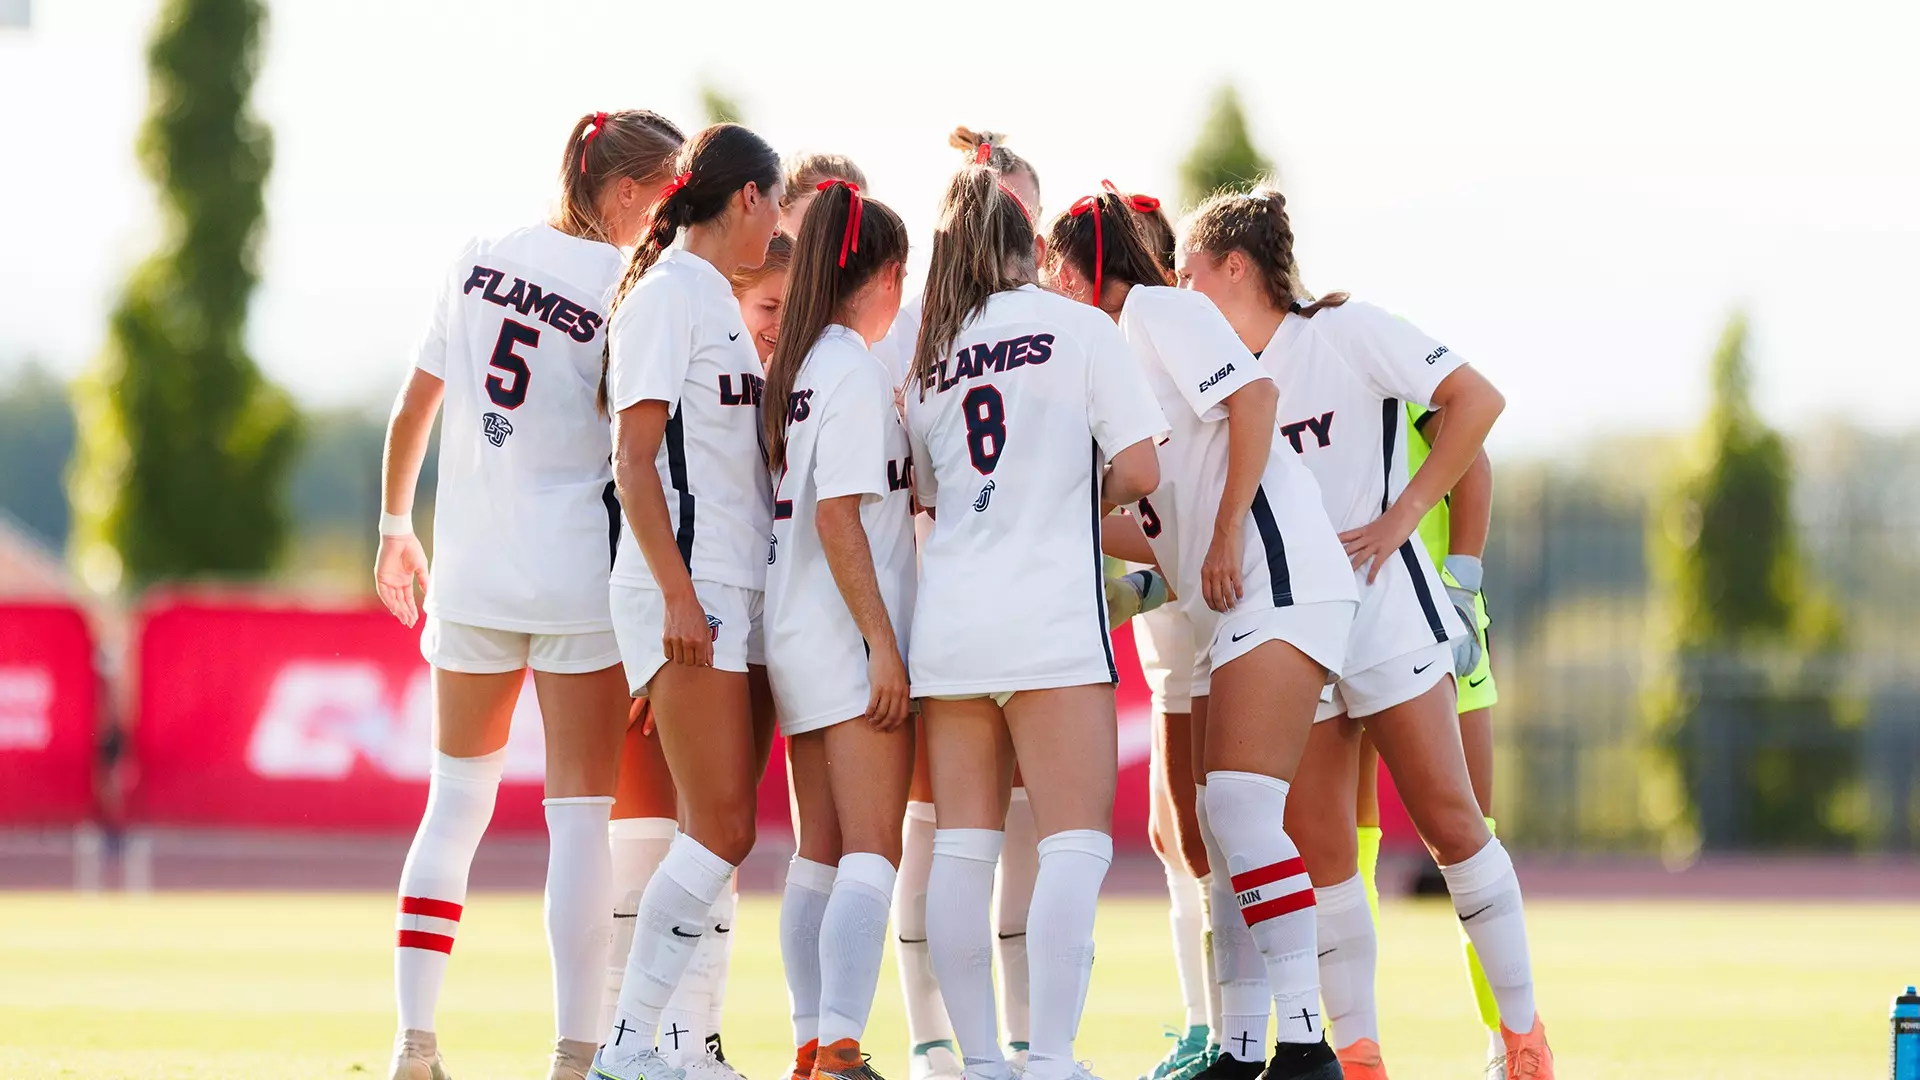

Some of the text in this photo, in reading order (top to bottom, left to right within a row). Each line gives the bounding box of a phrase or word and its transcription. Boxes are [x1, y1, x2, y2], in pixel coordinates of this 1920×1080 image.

[463, 265, 604, 343] FLAMES
[485, 317, 541, 411] 5
[961, 383, 1007, 476] 8
